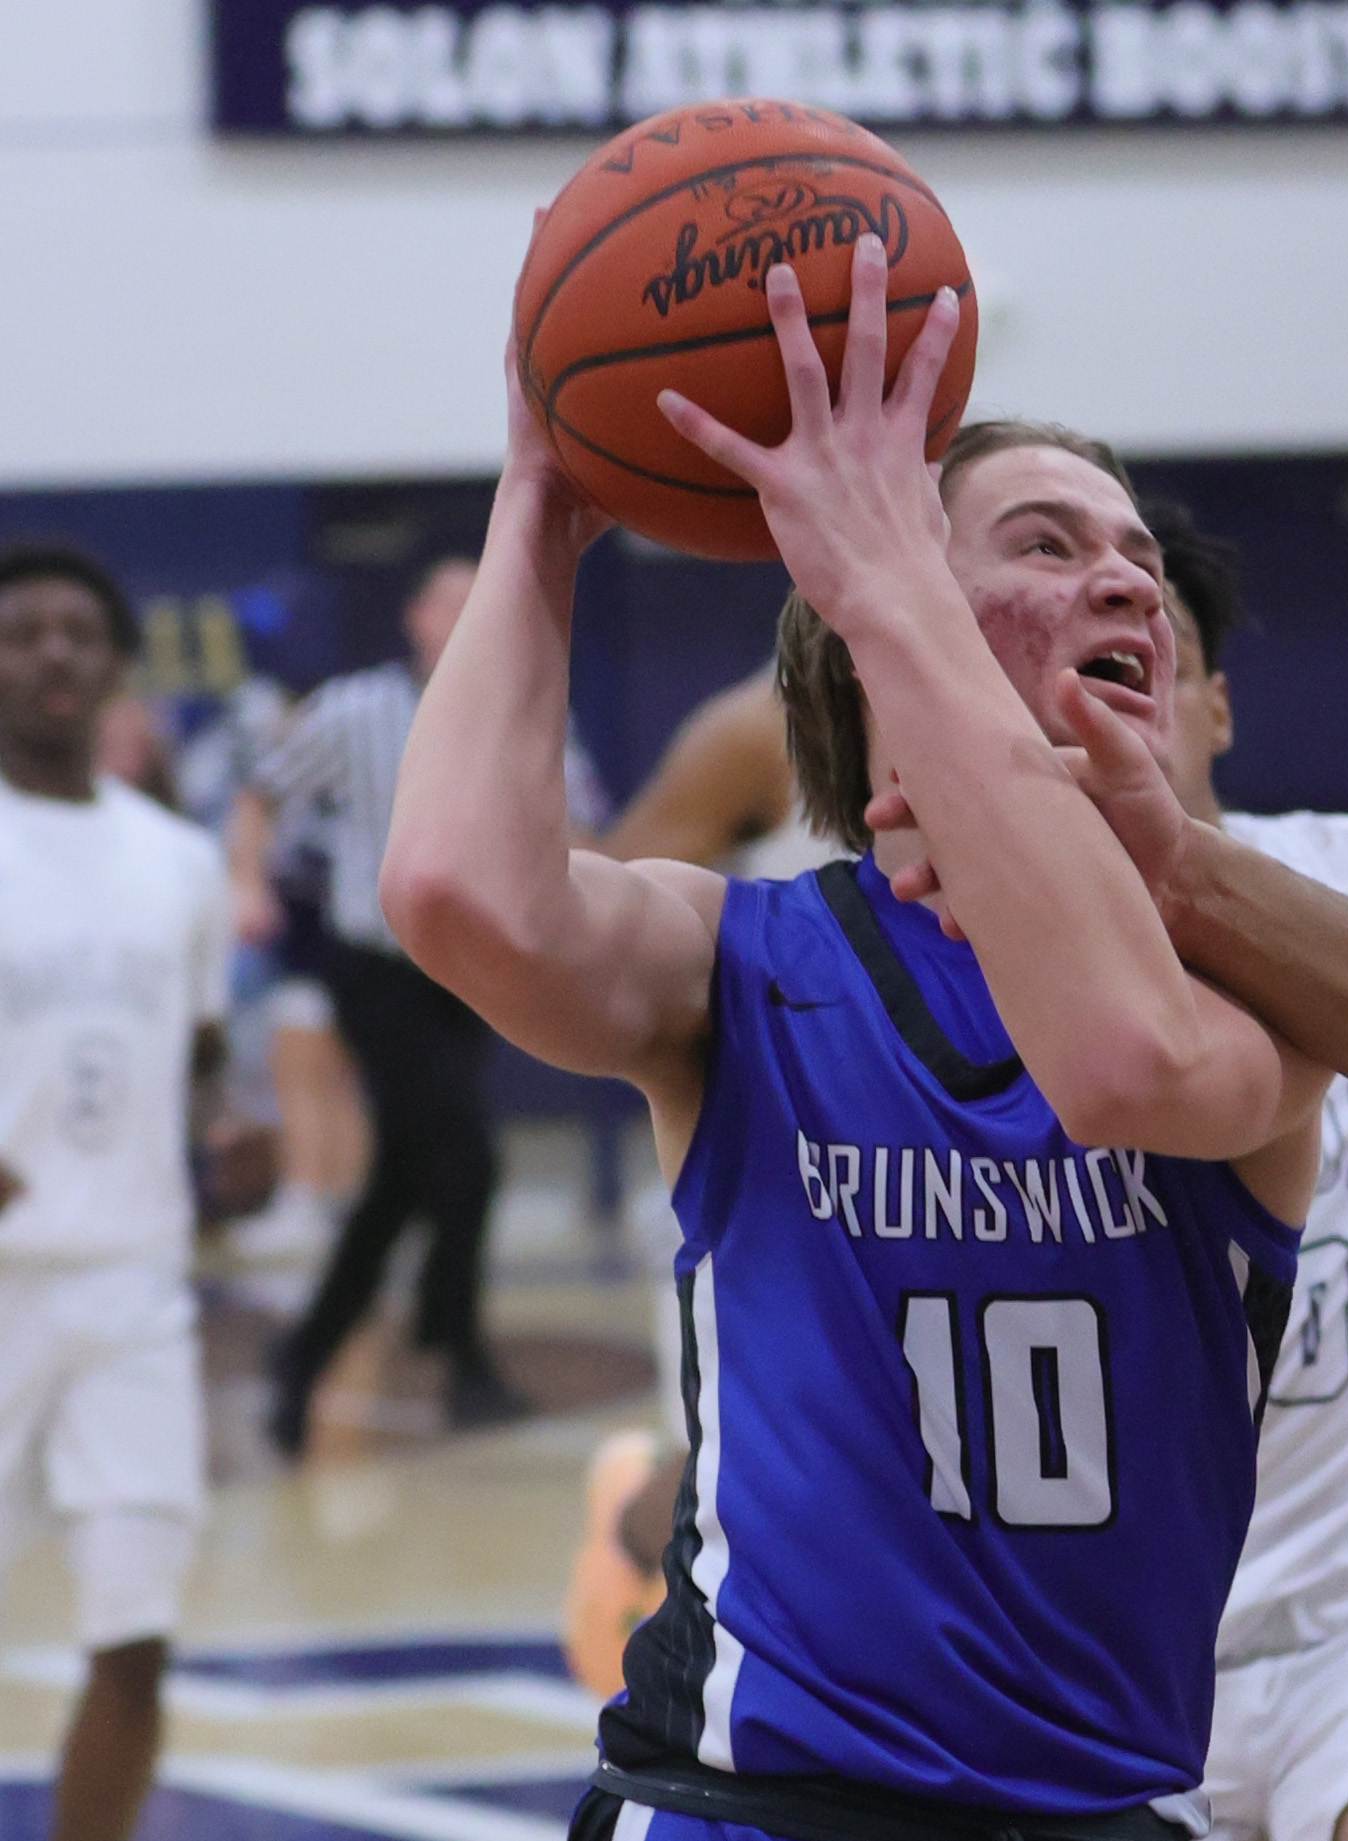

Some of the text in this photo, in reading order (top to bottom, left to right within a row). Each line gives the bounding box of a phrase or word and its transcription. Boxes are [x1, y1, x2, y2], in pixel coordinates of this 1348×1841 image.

[285, 5, 612, 127] SOLON
[620, 5, 1078, 120] ATHLETIC
[642, 194, 908, 318] Rawlings
[798, 1129, 1168, 1244] BRUNSWICK
[899, 1291, 1116, 1528] 10
